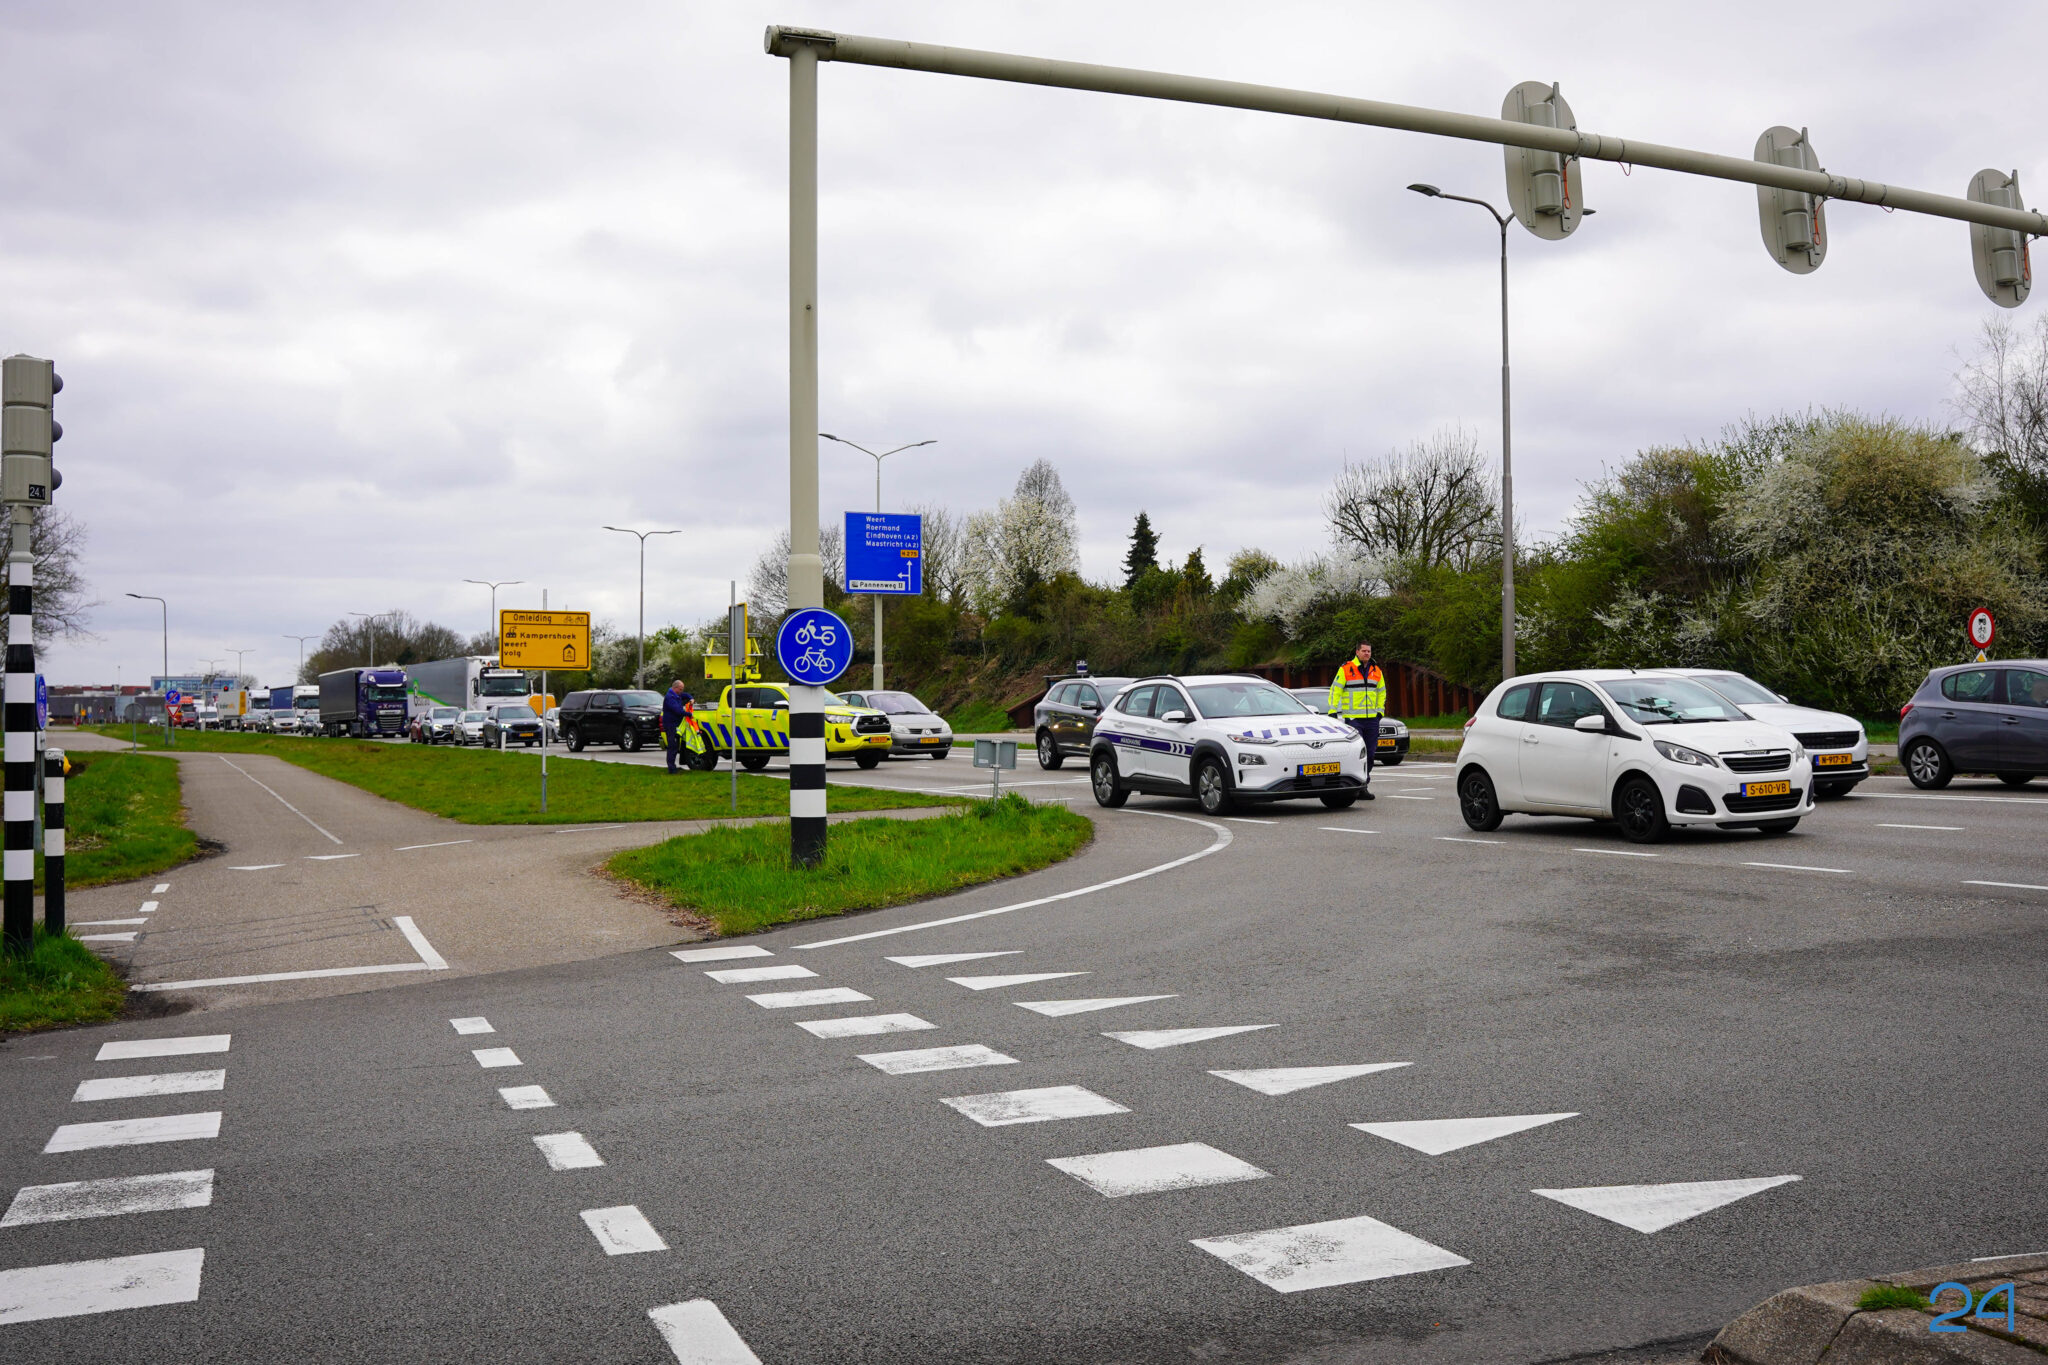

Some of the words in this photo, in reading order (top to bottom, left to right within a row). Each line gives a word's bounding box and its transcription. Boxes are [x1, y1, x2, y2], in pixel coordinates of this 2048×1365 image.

[30, 486, 45, 498] 24.1
[866, 540, 903, 548] Maastricht
[860, 582, 896, 590] Pannenweg
[513, 613, 552, 624] Omleiding
[520, 632, 577, 640] Kampershoek
[504, 650, 522, 658] volg
[1821, 755, 1849, 764] N-917-ZV
[1305, 764, 1338, 773] J-845-XH
[1750, 782, 1787, 795] S-610-VB
